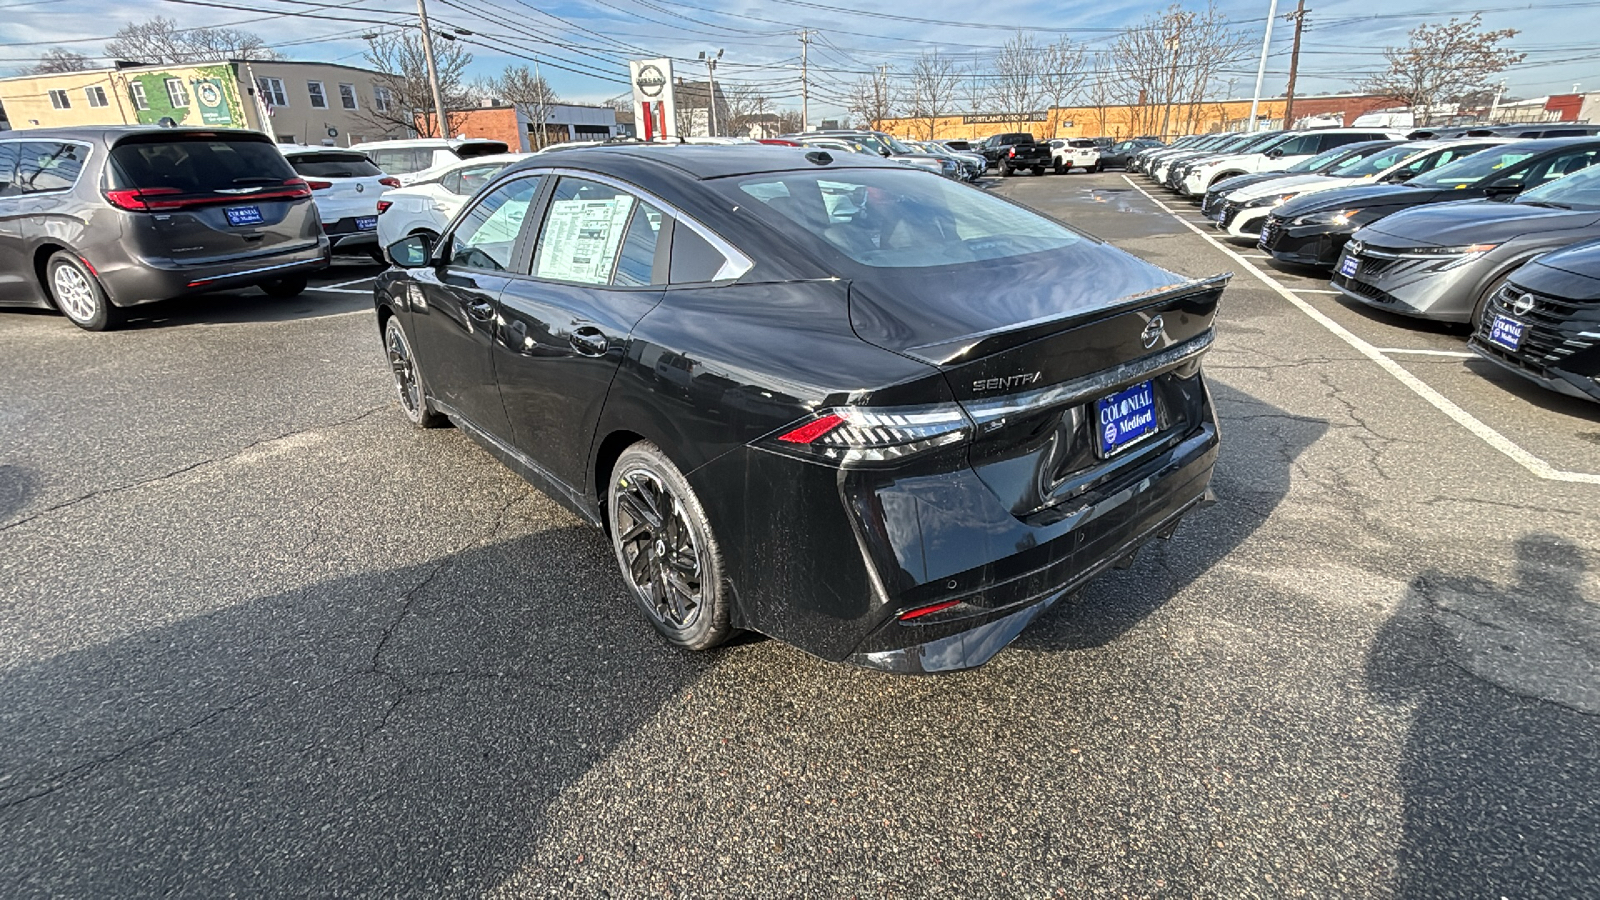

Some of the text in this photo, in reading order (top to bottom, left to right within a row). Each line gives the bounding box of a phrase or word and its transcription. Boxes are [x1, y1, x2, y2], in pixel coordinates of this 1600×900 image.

[967, 114, 1003, 123] PORTLAND
[972, 371, 1042, 391] SENTRA
[1101, 390, 1153, 425] COLONIAL
[1120, 409, 1152, 434] Medford
